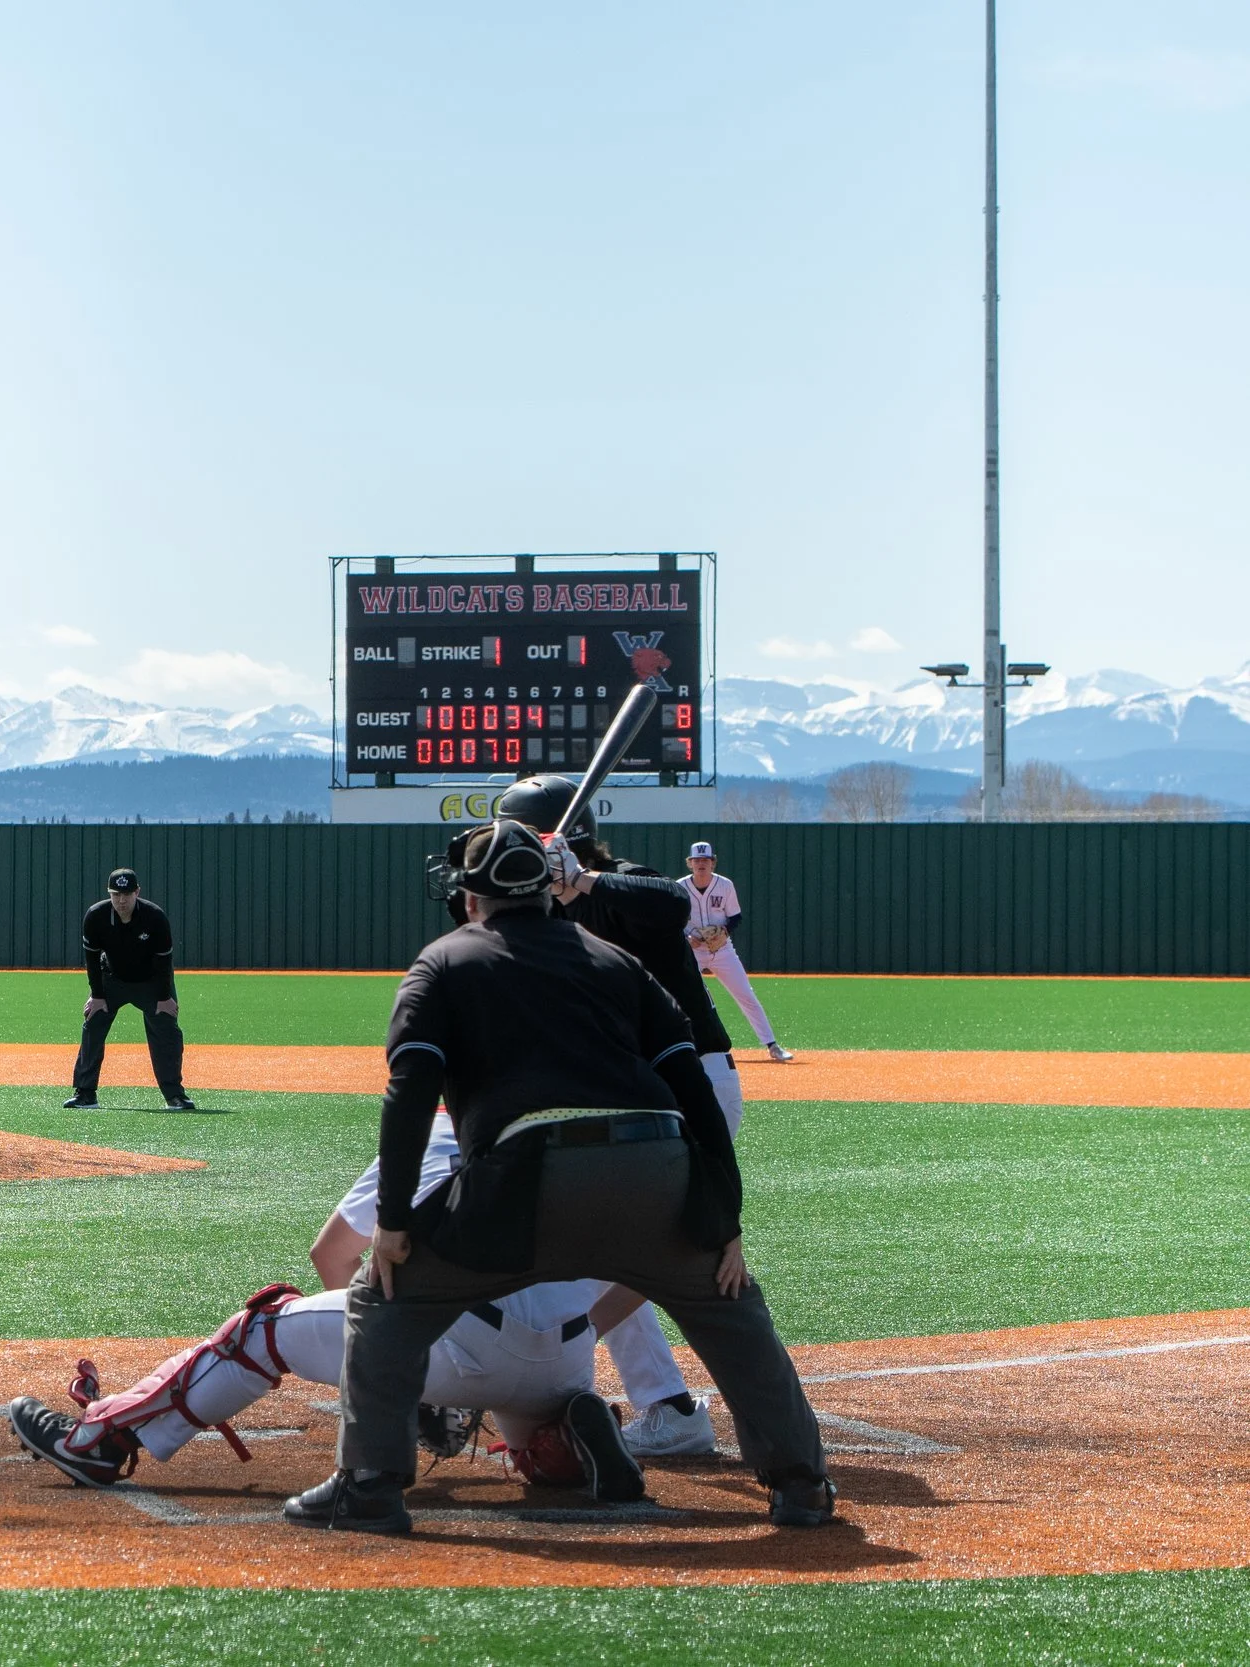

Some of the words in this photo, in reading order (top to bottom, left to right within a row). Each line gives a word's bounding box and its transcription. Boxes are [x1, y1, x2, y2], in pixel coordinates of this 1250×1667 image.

[358, 585, 524, 614] WILDCATS
[532, 583, 688, 612] BASEBALL
[353, 647, 395, 661] BALL
[421, 645, 481, 661] STRIKE
[526, 645, 562, 659] OUT
[419, 687, 429, 699] 1
[441, 687, 452, 699] 2
[463, 687, 474, 699] 3
[484, 686, 495, 699] 4
[507, 686, 518, 698] 5
[529, 686, 540, 698] 6
[552, 686, 562, 698] 7
[574, 686, 585, 698] 8
[596, 686, 607, 698] 9
[678, 685, 689, 697] R
[356, 711, 411, 727] GUEST
[356, 745, 407, 760] HOME
[697, 845, 707, 854] W
[710, 895, 723, 908] W
